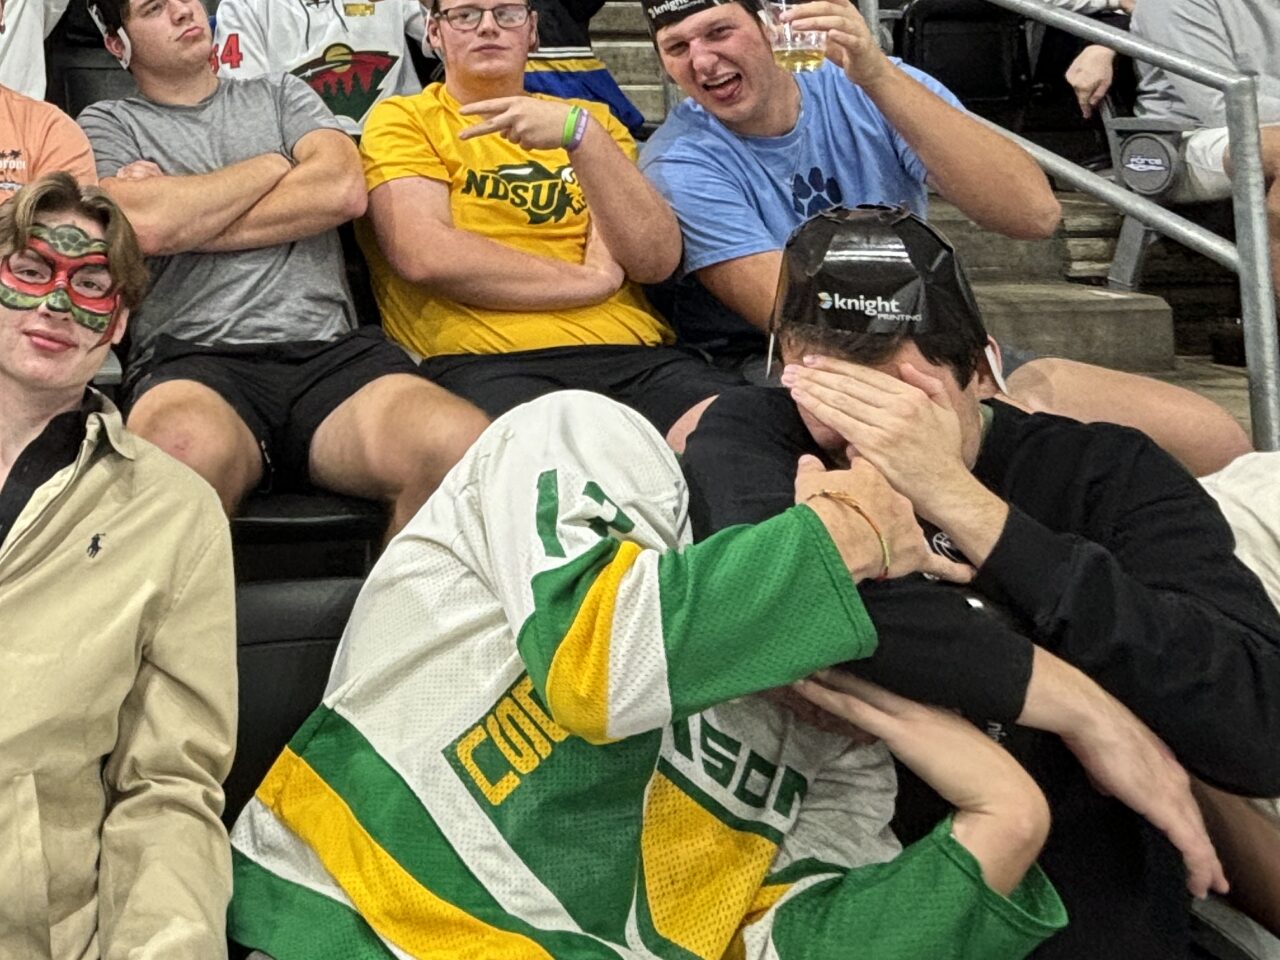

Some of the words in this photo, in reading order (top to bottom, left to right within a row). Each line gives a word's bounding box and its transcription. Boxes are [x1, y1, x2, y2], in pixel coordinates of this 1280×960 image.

[460, 168, 560, 212] NDSU
[833, 292, 901, 316] knight
[877, 313, 922, 321] PRINTING
